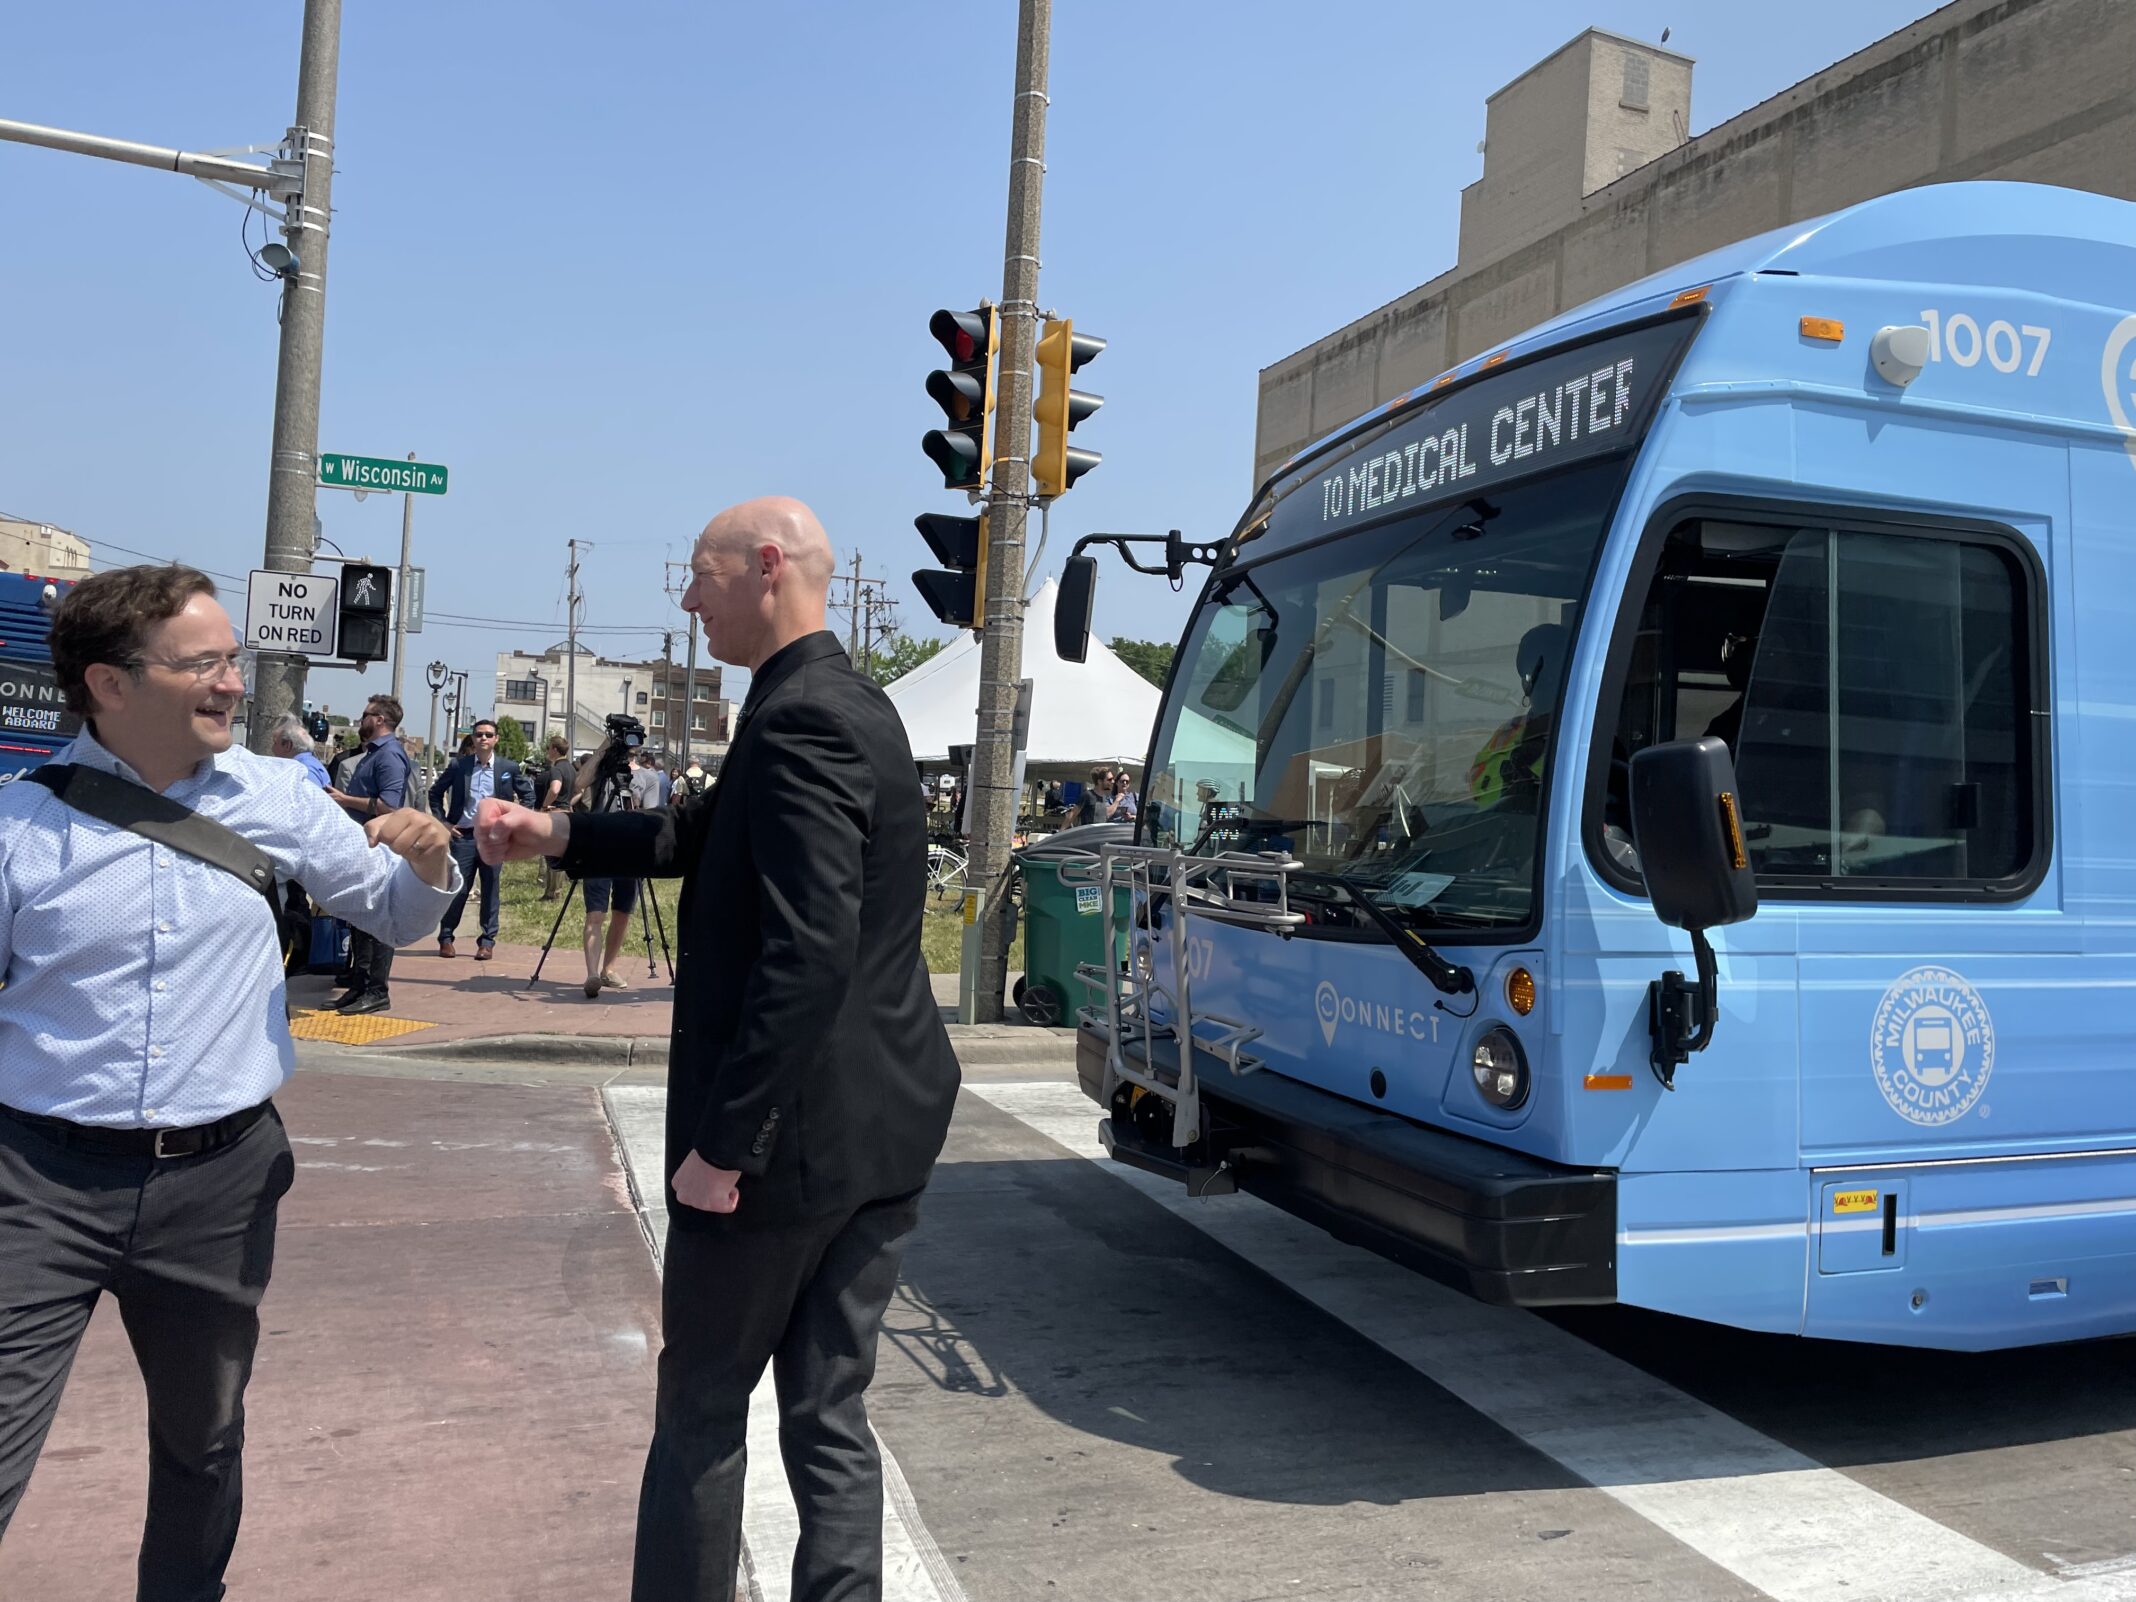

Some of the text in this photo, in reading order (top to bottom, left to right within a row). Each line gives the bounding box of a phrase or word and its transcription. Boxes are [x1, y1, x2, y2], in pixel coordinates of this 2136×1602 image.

[1920, 309, 2052, 377] 1007
[1323, 357, 1634, 520] TO MEDICAL CENTER
[325, 458, 443, 488] W Wisconsin Av
[278, 582, 308, 599] NO
[269, 603, 316, 622] TURN
[258, 624, 322, 644] ON RED
[2, 705, 61, 722] WELCOME
[4, 716, 57, 731] ABOARD
[1078, 887, 1098, 897] BIG
[1319, 990, 1440, 1044] CONNECT
[1886, 985, 1981, 1047] MILWAUKEE
[1893, 1069, 1973, 1108] COUNTY
